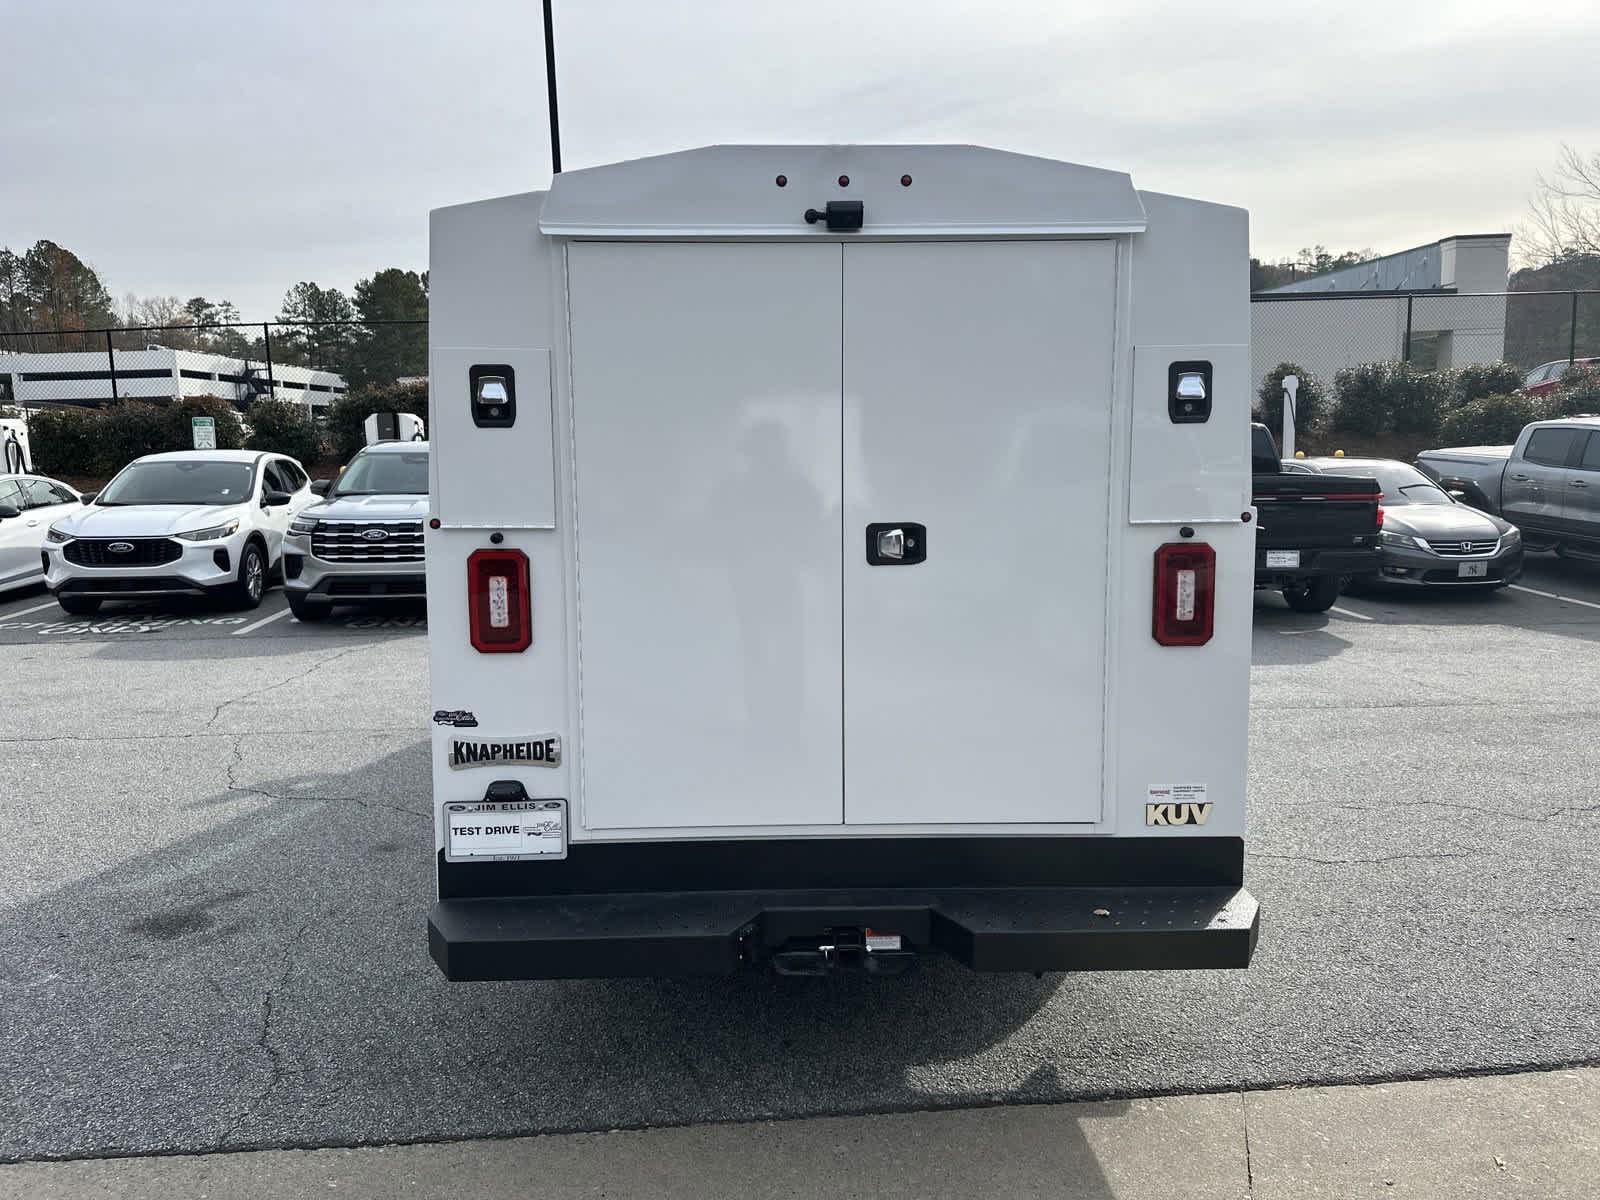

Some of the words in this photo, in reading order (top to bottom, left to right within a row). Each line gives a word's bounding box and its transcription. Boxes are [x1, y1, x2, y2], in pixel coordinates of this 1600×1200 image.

[38, 625, 168, 635] ONLY
[453, 738, 556, 765] KNAPHEIDE
[502, 802, 536, 811] ELLIS
[1145, 802, 1213, 826] KUV
[452, 826, 482, 836] TEST
[485, 825, 520, 835] DRIVE
